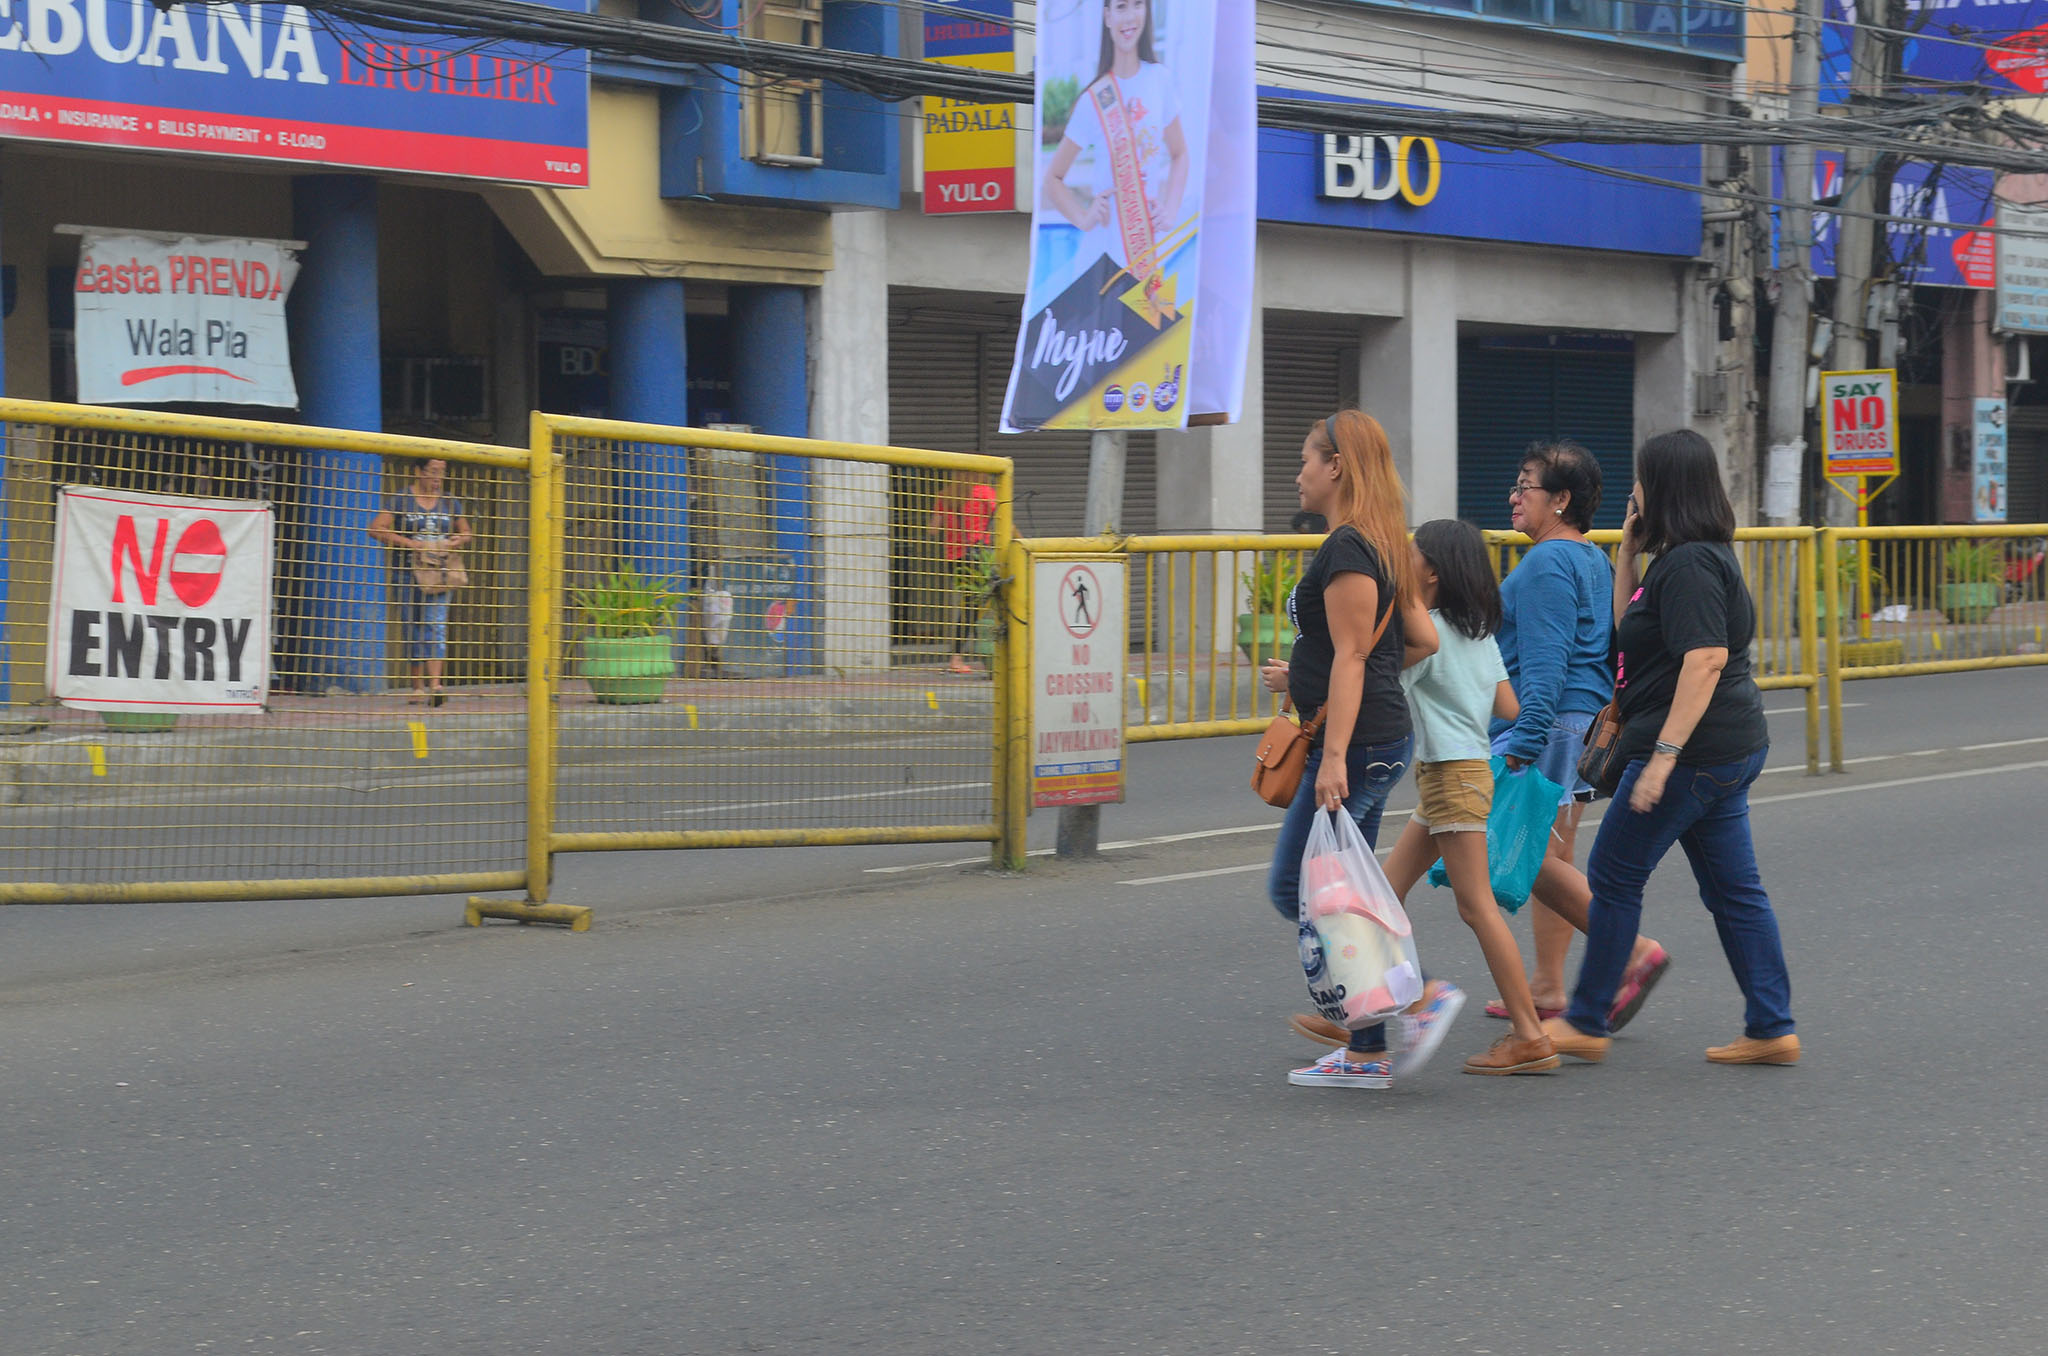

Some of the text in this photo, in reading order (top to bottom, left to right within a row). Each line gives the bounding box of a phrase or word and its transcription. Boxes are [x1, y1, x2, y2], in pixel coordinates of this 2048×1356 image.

[337, 40, 558, 105] LHUILLIER
[0, 103, 326, 149] DALA INSURANCE BILLS PAYMENT E-LOAD
[925, 109, 1014, 134] PADALA
[545, 160, 582, 174] YULO
[1324, 133, 1441, 207] BDO
[938, 181, 1001, 202] YULO
[75, 255, 161, 294] Basta
[126, 318, 248, 358] Wala Pia
[1832, 382, 1883, 398] SAY
[1832, 396, 1885, 432] NO
[1834, 431, 1887, 451] DRUGS
[111, 514, 227, 608] NO
[68, 609, 252, 682] ENTRY
[1072, 645, 1090, 666] NO
[1046, 672, 1113, 697] CROSSING
[1072, 702, 1090, 723] NO
[1038, 728, 1118, 754] JAYWALKING
[1307, 983, 1346, 1005] SANO
